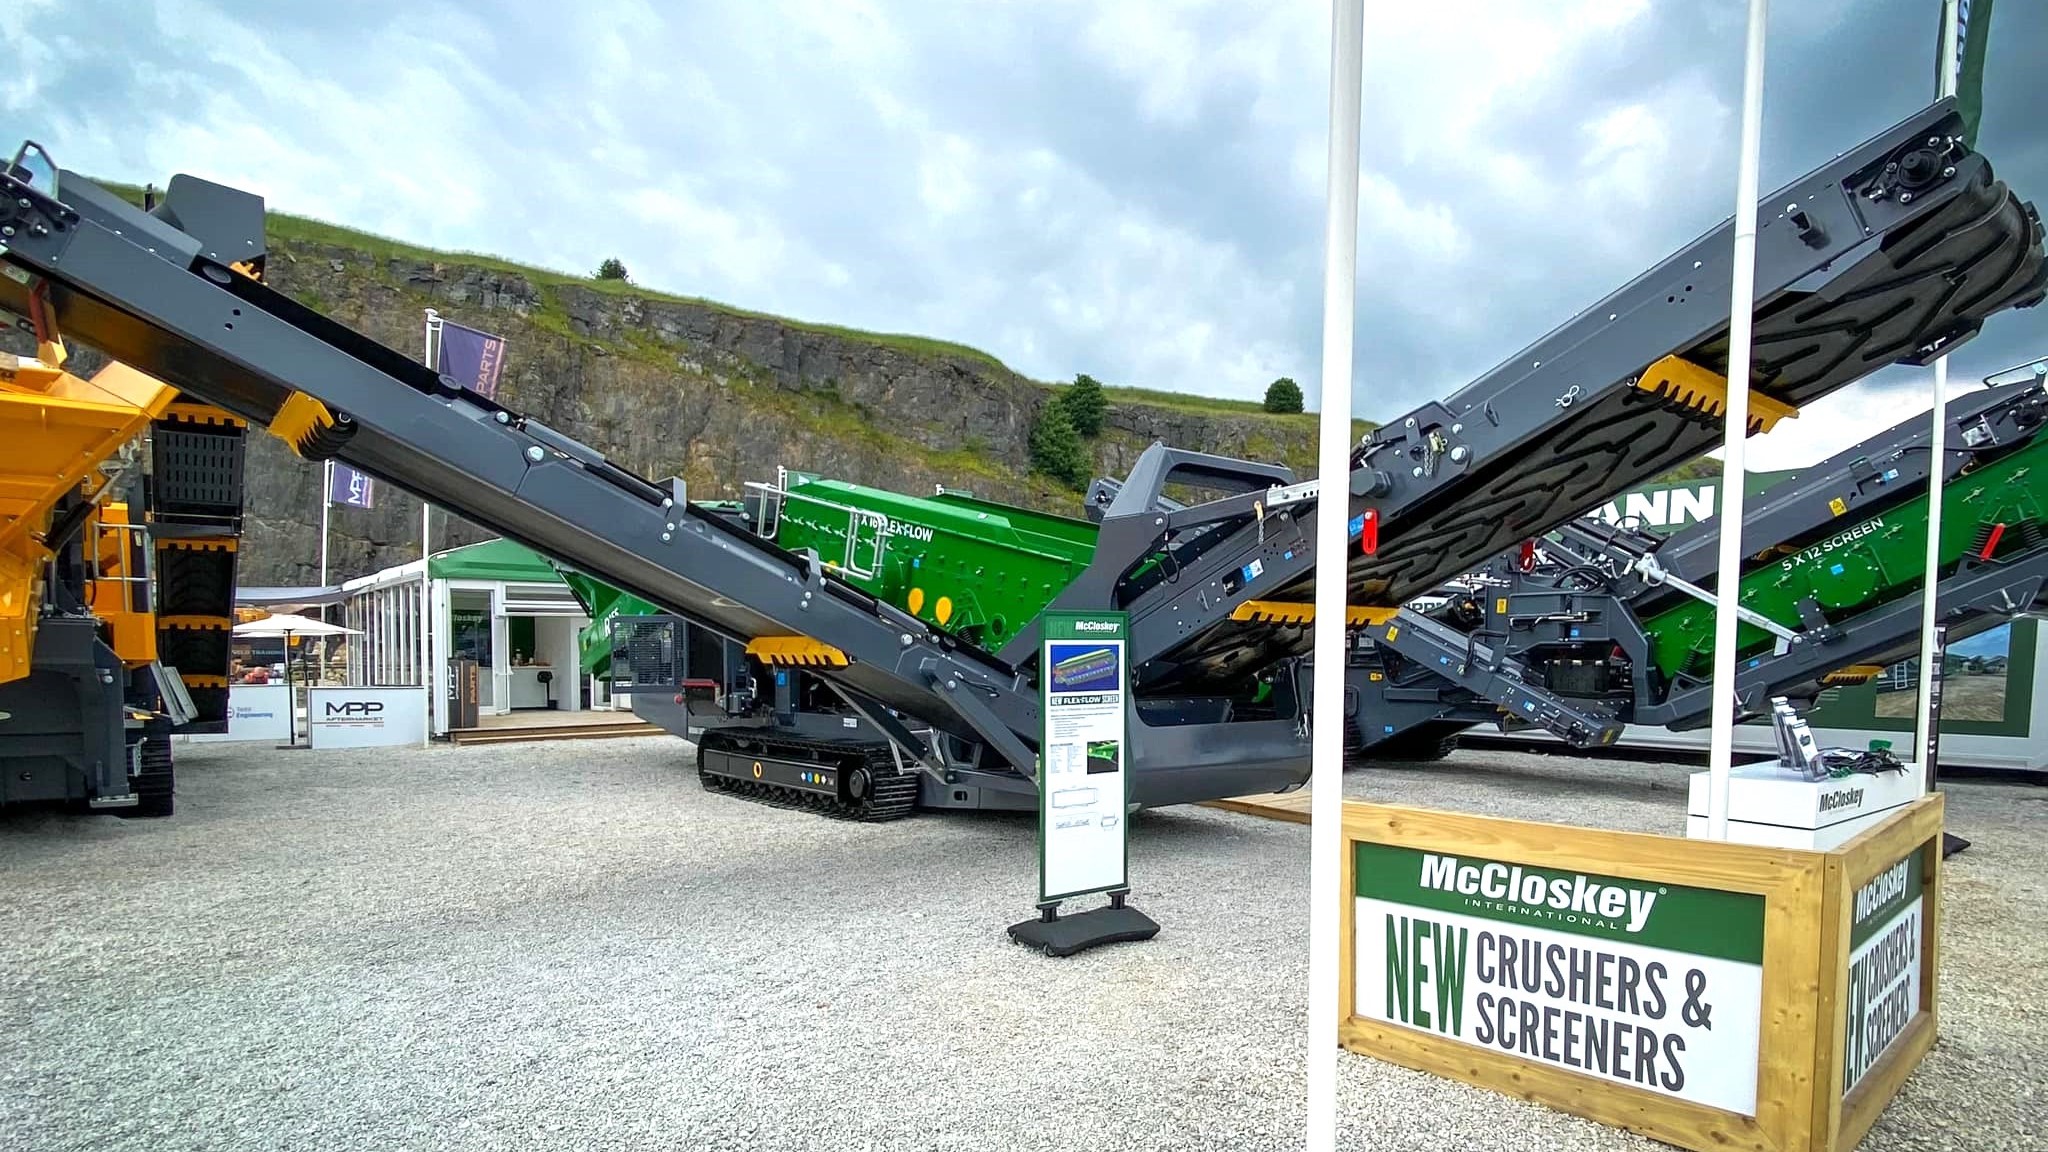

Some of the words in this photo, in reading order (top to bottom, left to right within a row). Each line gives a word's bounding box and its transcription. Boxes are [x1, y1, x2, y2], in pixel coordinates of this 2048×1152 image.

[475, 338, 497, 394] PARTS
[1583, 485, 1715, 529] ANN
[1781, 559, 1793, 572] 5
[1793, 553, 1806, 567] X
[1805, 546, 1823, 560] 12
[1822, 517, 1885, 552] SCREEN
[1075, 620, 1120, 633] McCloskey
[325, 701, 384, 716] MPP
[1819, 787, 1864, 813] McCloskey
[1464, 898, 1618, 931] INTERNATIONAL
[1855, 858, 1910, 924] McCloskey
[1386, 913, 1468, 1037] NEW
[1476, 930, 1668, 1020] CRUSHERS
[1681, 967, 1712, 1031] &
[1843, 952, 1869, 1093] EW
[1867, 918, 1909, 1004] CRUSHERS
[1909, 912, 1916, 963] &
[1475, 991, 1686, 1092] SCREENERS
[1865, 973, 1911, 1069] SCREENERS
